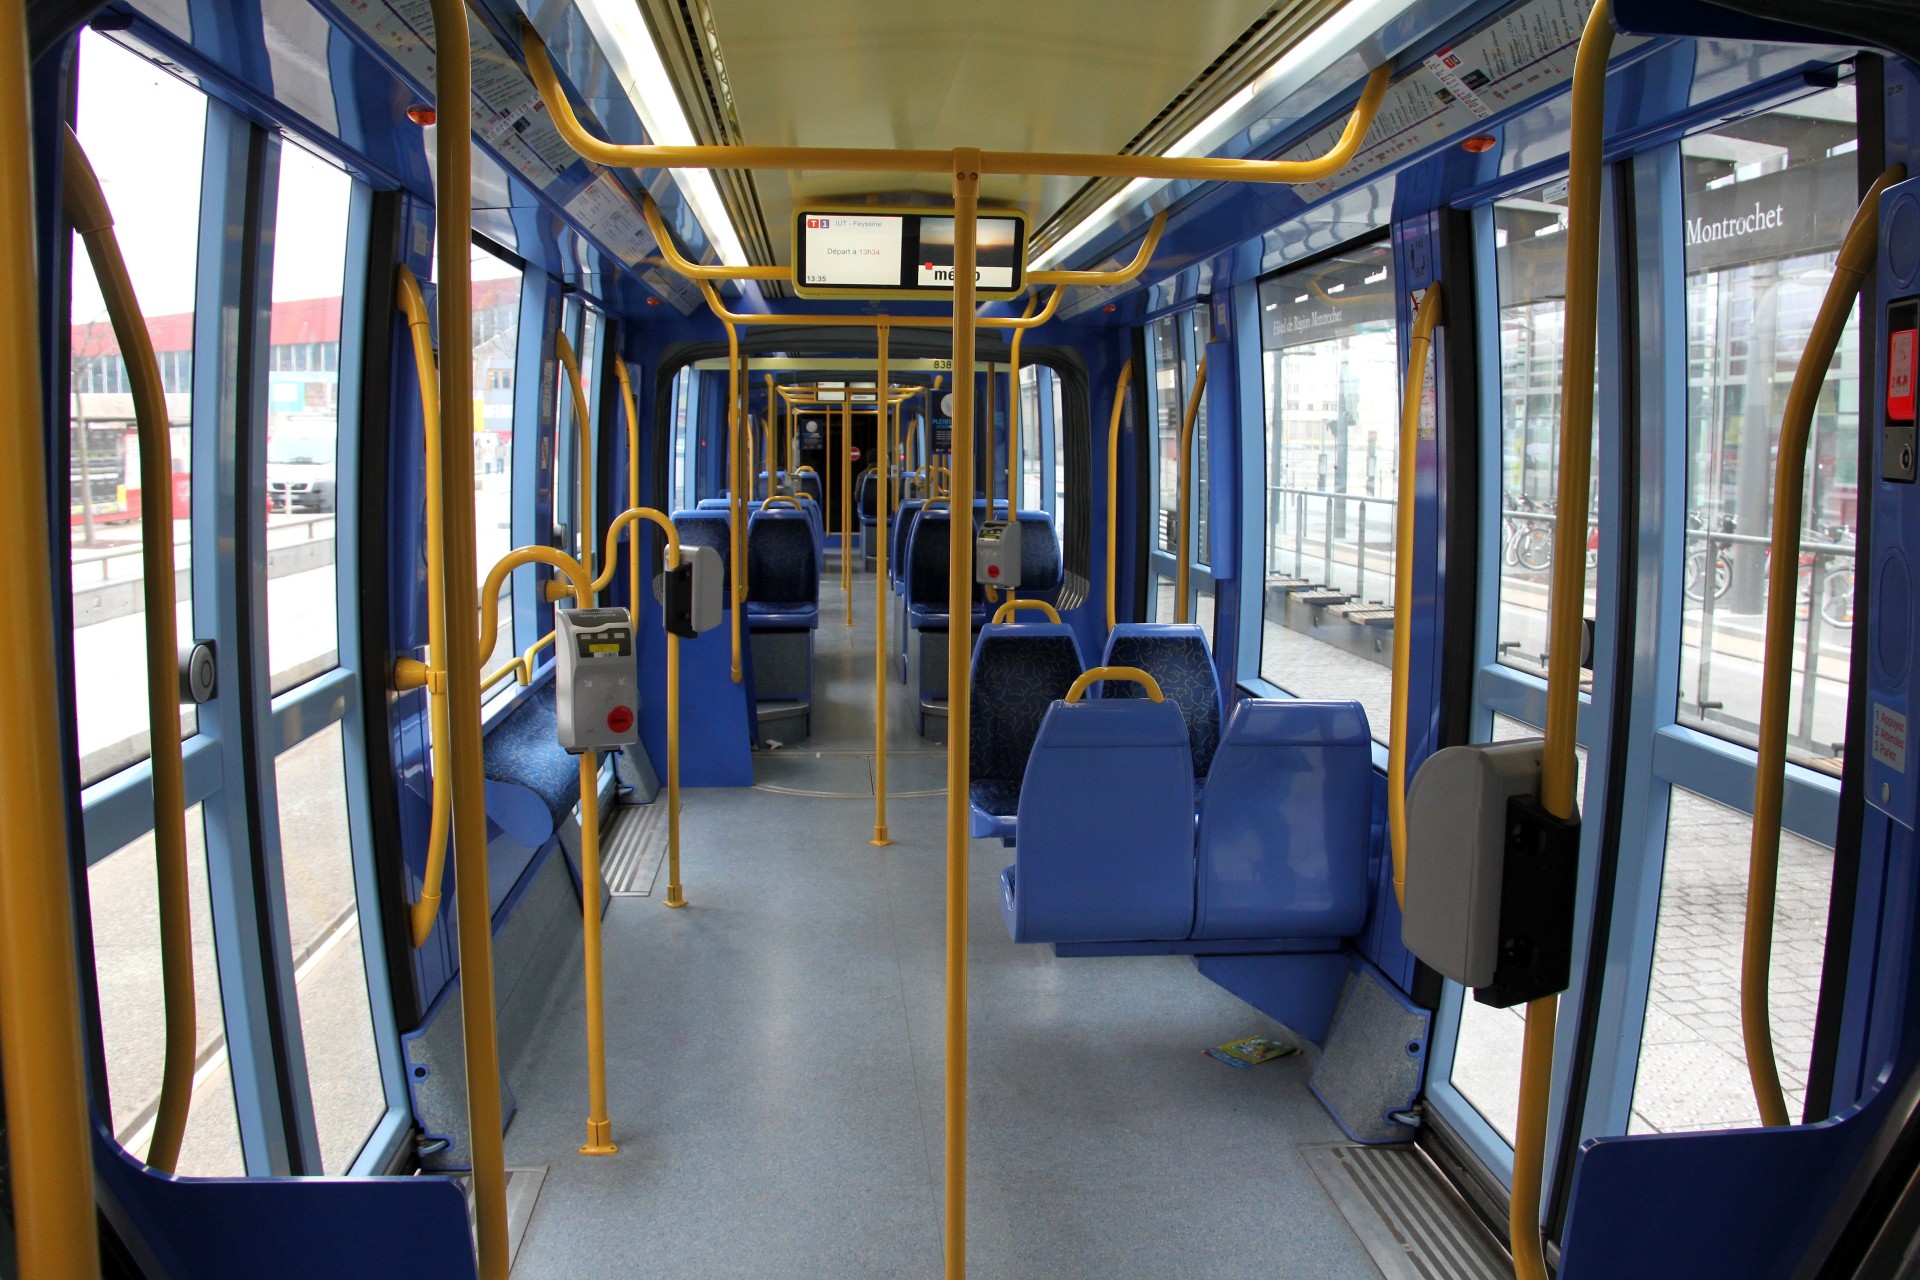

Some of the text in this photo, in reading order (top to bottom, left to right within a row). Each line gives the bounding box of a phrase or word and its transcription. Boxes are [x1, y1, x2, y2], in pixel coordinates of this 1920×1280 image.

[1887, 84, 1904, 96] 23
[853, 220, 882, 228] Feyssine
[1686, 201, 1784, 246] Montrochet
[827, 247, 851, 256] Départ
[859, 248, 881, 256] 13h34
[1287, 316, 1293, 332] de
[1311, 306, 1343, 328] Montrochet
[933, 360, 952, 369] 838
[1881, 712, 1905, 733] Appuyez
[1881, 728, 1905, 749] Attendez
[1880, 743, 1897, 761] Parlez
